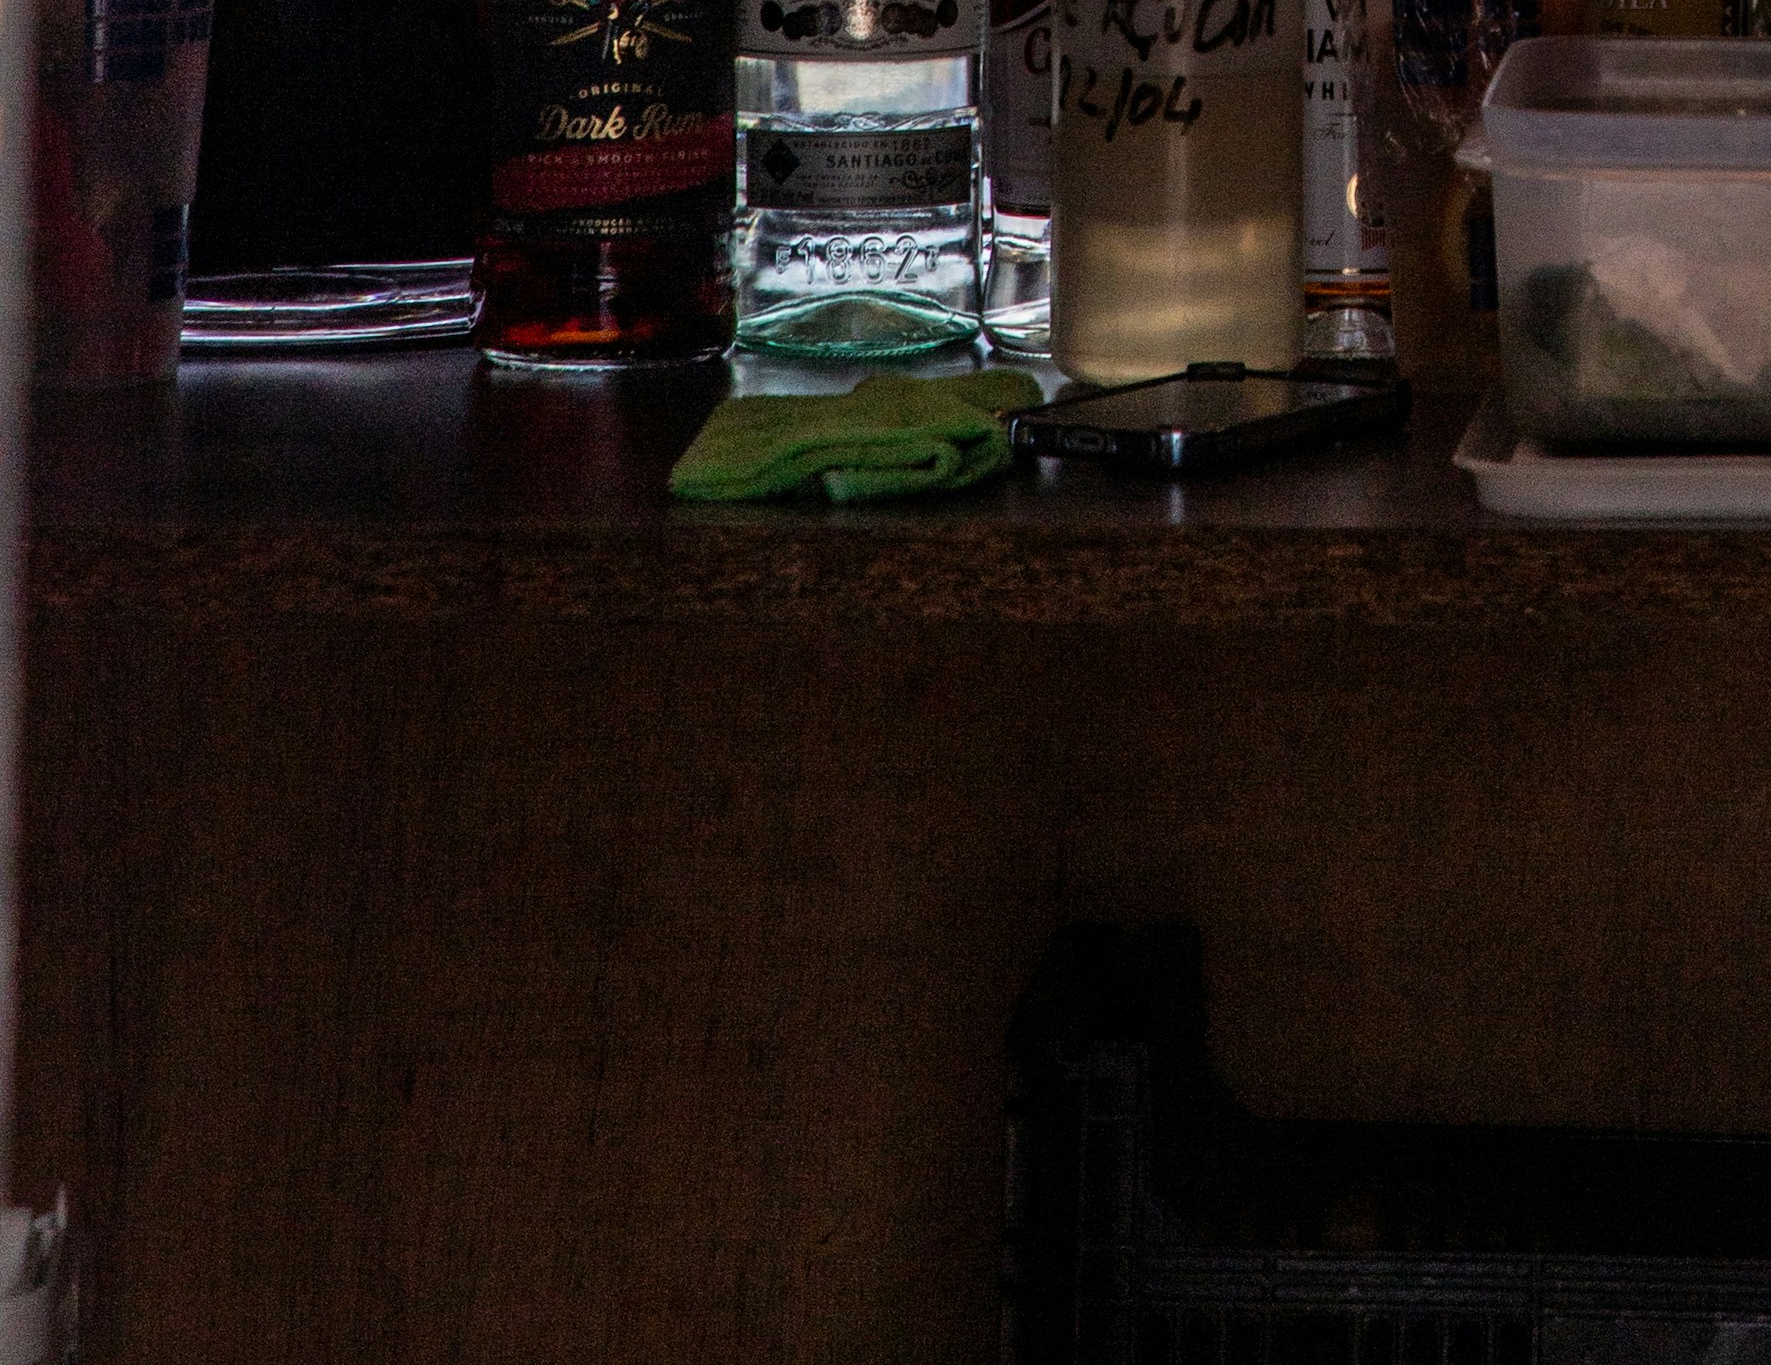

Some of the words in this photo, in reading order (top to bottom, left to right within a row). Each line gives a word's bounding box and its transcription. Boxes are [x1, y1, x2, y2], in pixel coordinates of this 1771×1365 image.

[577, 81, 665, 99] ORIGINAL
[534, 104, 628, 141] Dark
[632, 102, 705, 142] Rum
[826, 153, 918, 169] SANTIAGO
[797, 235, 919, 286] 1862
